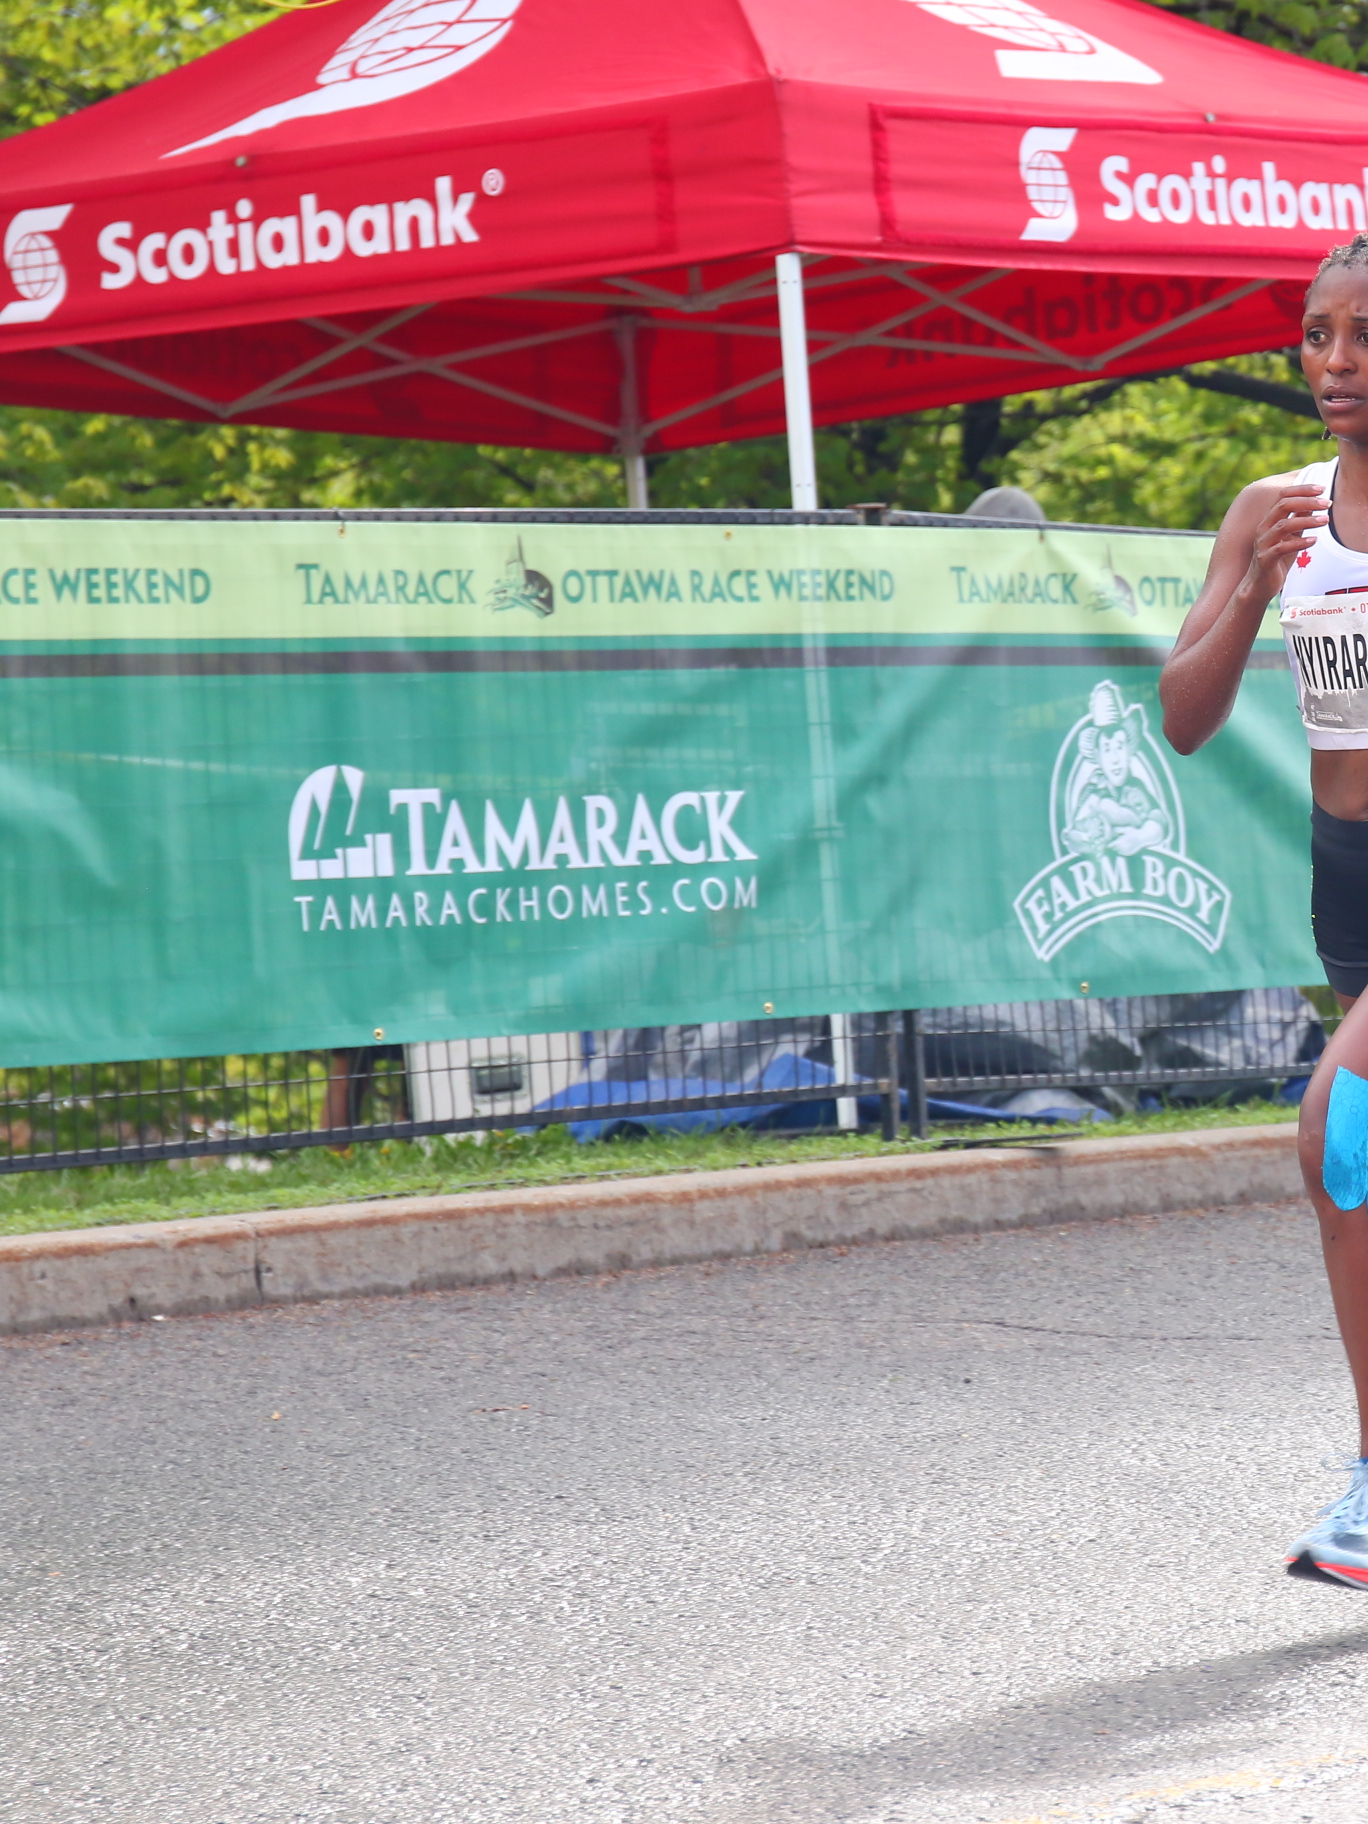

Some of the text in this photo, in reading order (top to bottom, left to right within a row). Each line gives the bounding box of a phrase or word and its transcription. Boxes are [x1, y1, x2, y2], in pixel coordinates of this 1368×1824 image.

[0, 567, 211, 605] CE WEEKEND
[295, 563, 895, 605] TAMARACK OTTAWA RACE WEEKEND
[949, 566, 1079, 605] TAMARACK
[1299, 605, 1345, 617] Scotiabank
[389, 788, 758, 876] TAMARACK
[293, 875, 758, 933] TAMARACKHOMES.COM
[1024, 854, 1222, 939] FARM BOY
